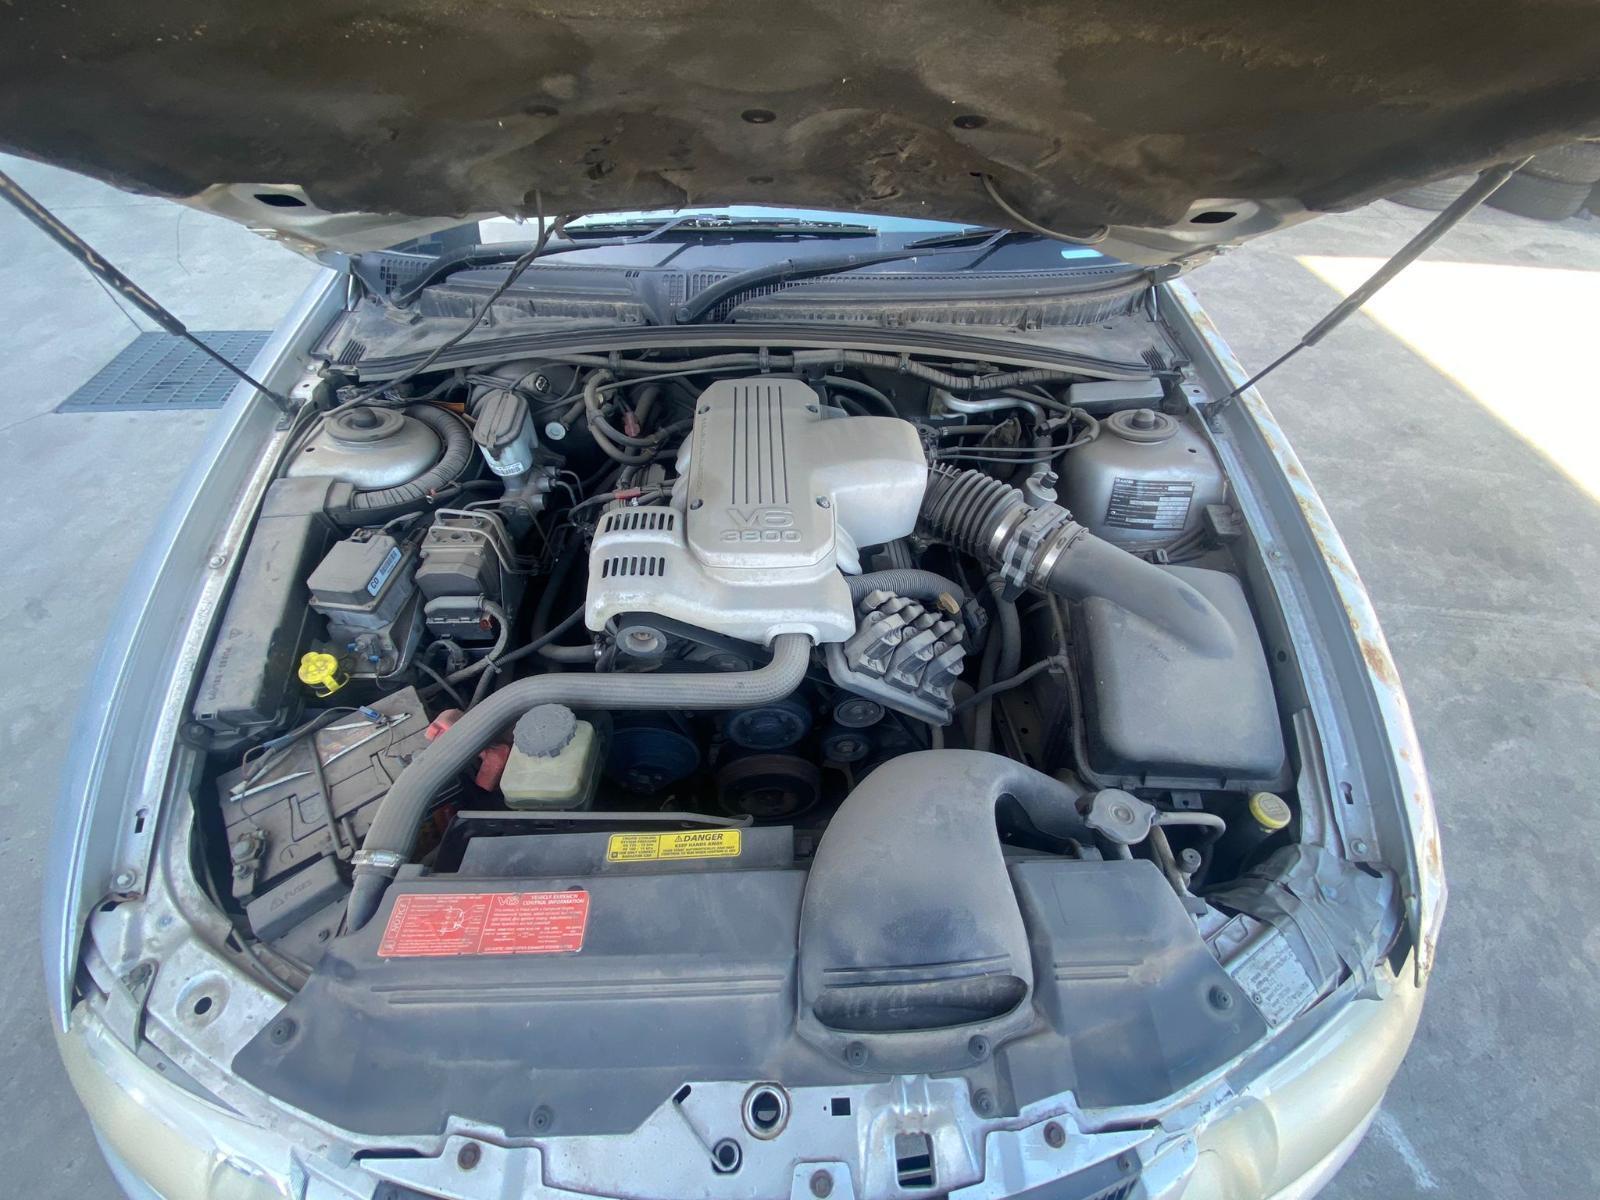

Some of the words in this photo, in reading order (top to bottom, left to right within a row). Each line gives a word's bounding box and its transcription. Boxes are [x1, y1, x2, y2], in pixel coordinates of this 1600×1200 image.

[726, 506, 794, 529] V6
[720, 528, 802, 543] 3800
[683, 833, 724, 842] DANGER
